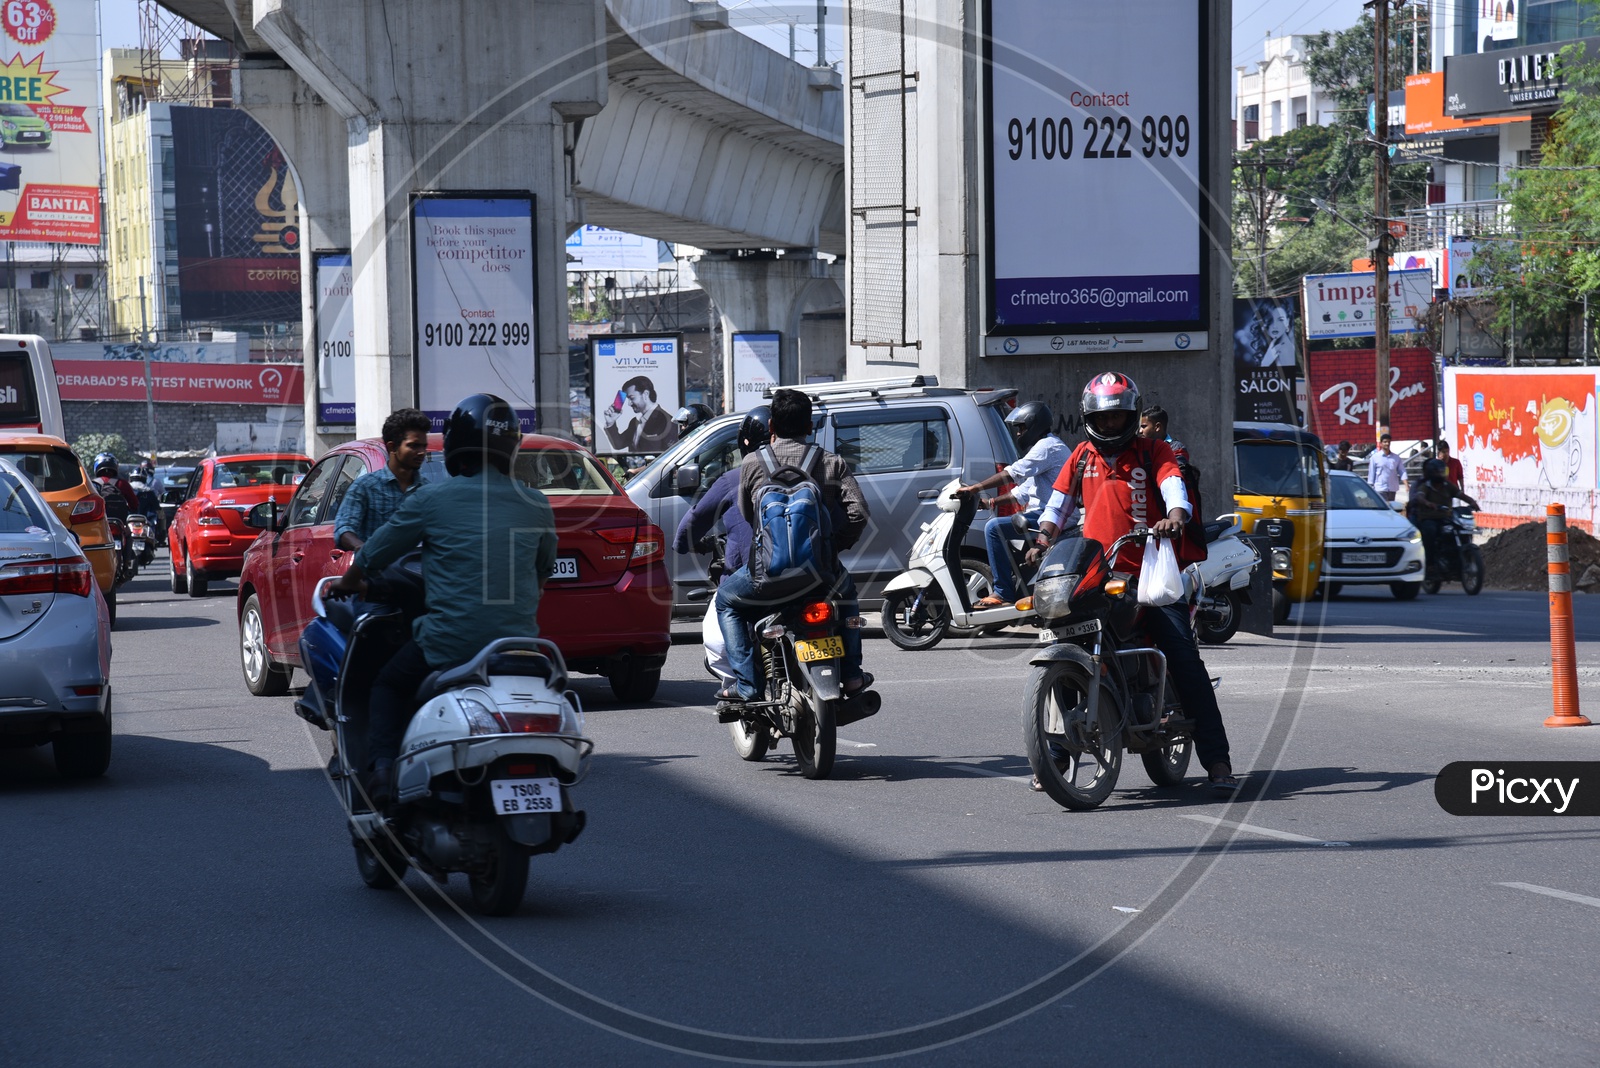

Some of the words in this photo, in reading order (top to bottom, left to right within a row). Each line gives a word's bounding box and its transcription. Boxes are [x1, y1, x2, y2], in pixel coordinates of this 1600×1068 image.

[7, 2, 53, 27] 63%
[17, 27, 37, 40] Off
[1070, 91, 1130, 107] Contact
[1509, 92, 1533, 102] UNISEX
[1534, 89, 1556, 99] SALON
[1008, 117, 1074, 161] 9100
[1083, 116, 1132, 159] 222
[1142, 114, 1190, 158] 999
[31, 197, 90, 212] BANTIA
[434, 225, 461, 235] Book
[464, 225, 485, 235] this
[487, 227, 516, 237] space
[426, 237, 460, 247] before
[463, 239, 487, 249] your
[437, 245, 526, 263] competitor
[1453, 250, 1471, 258] New
[481, 261, 511, 273] does
[247, 267, 299, 284] coming
[1010, 287, 1189, 308] cfmetro365@gmail.com
[1318, 280, 1402, 305] impat
[461, 309, 495, 318] Contact
[425, 323, 463, 346] 9100
[468, 323, 497, 346] 222
[502, 323, 530, 346] 999
[323, 340, 352, 357] 9100
[188, 377, 253, 390] NETWORK
[737, 382, 753, 392] 9100
[1240, 378, 1291, 394] SALON
[1319, 366, 1427, 426] RayBan
[1065, 627, 1076, 637] AQ
[1081, 622, 1099, 633] 3361
[806, 640, 819, 650] TS
[825, 638, 837, 648] 13
[802, 647, 843, 660] UB3639
[511, 783, 541, 797] TS08
[502, 799, 519, 812] EB
[524, 797, 553, 810] 2558
